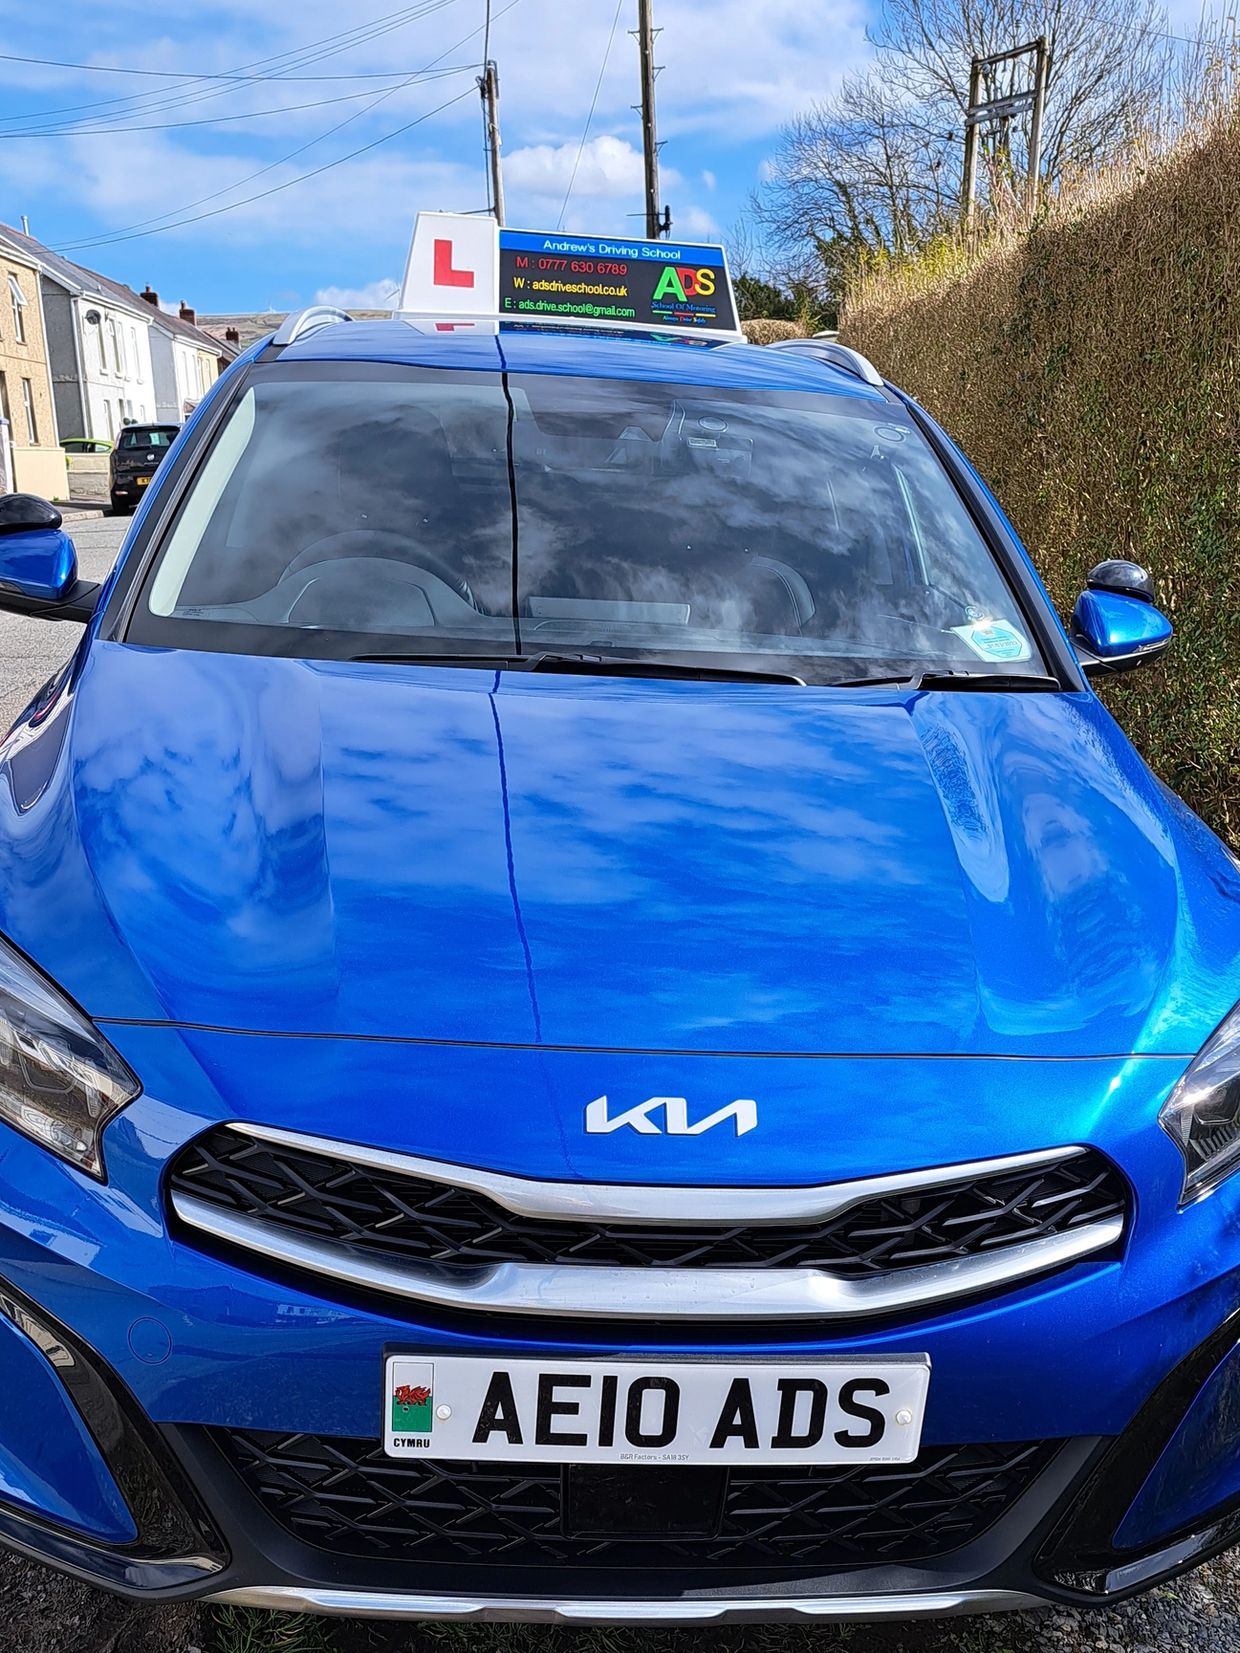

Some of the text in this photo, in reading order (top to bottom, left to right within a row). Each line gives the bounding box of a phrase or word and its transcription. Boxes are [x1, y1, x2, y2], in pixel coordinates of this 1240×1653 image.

[543, 239, 681, 260] Andrew's Driving School
[434, 239, 474, 288] L
[538, 258, 567, 271] 0777
[570, 260, 594, 273] 630
[597, 262, 627, 275] 6789
[532, 279, 628, 297] adsdriveschool.co.uk
[652, 266, 715, 302] ADS
[518, 300, 635, 317] ads.drive.school@gmail.com
[651, 301, 674, 310] School
[586, 1095, 757, 1137] KIA
[708, 1377, 891, 1449] ADS
[393, 1437, 430, 1448] CYMRU
